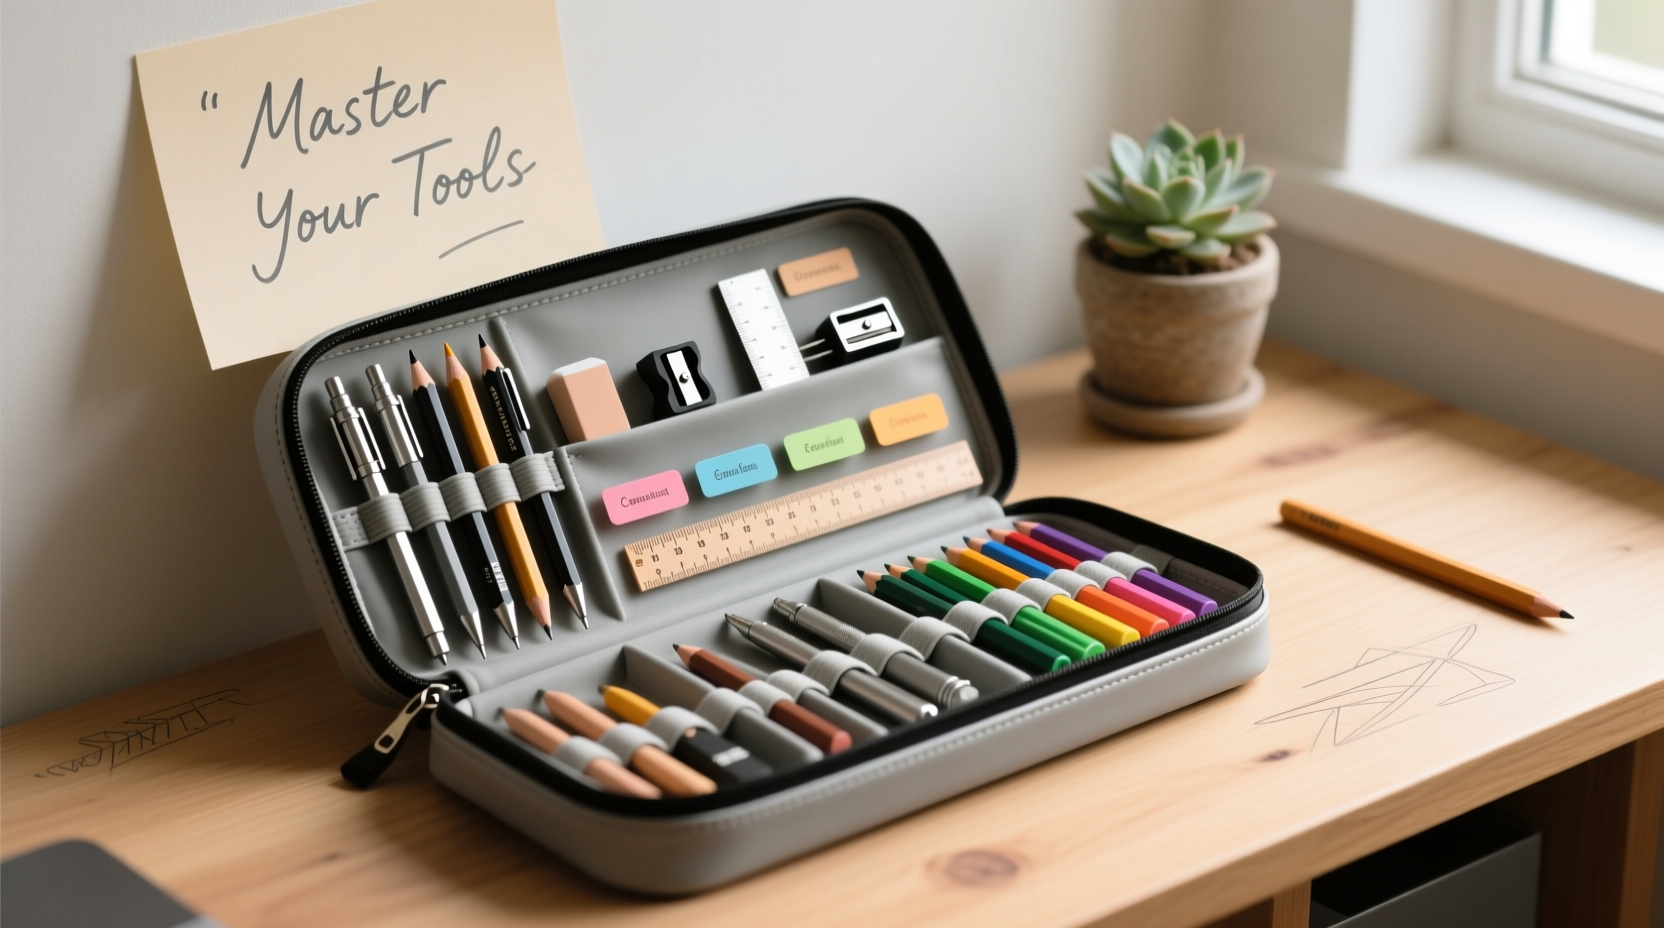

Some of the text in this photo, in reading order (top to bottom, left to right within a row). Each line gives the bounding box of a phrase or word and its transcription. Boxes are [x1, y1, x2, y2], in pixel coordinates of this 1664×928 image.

[240, 65, 447, 170] Master
[251, 125, 537, 284] Your Tools
